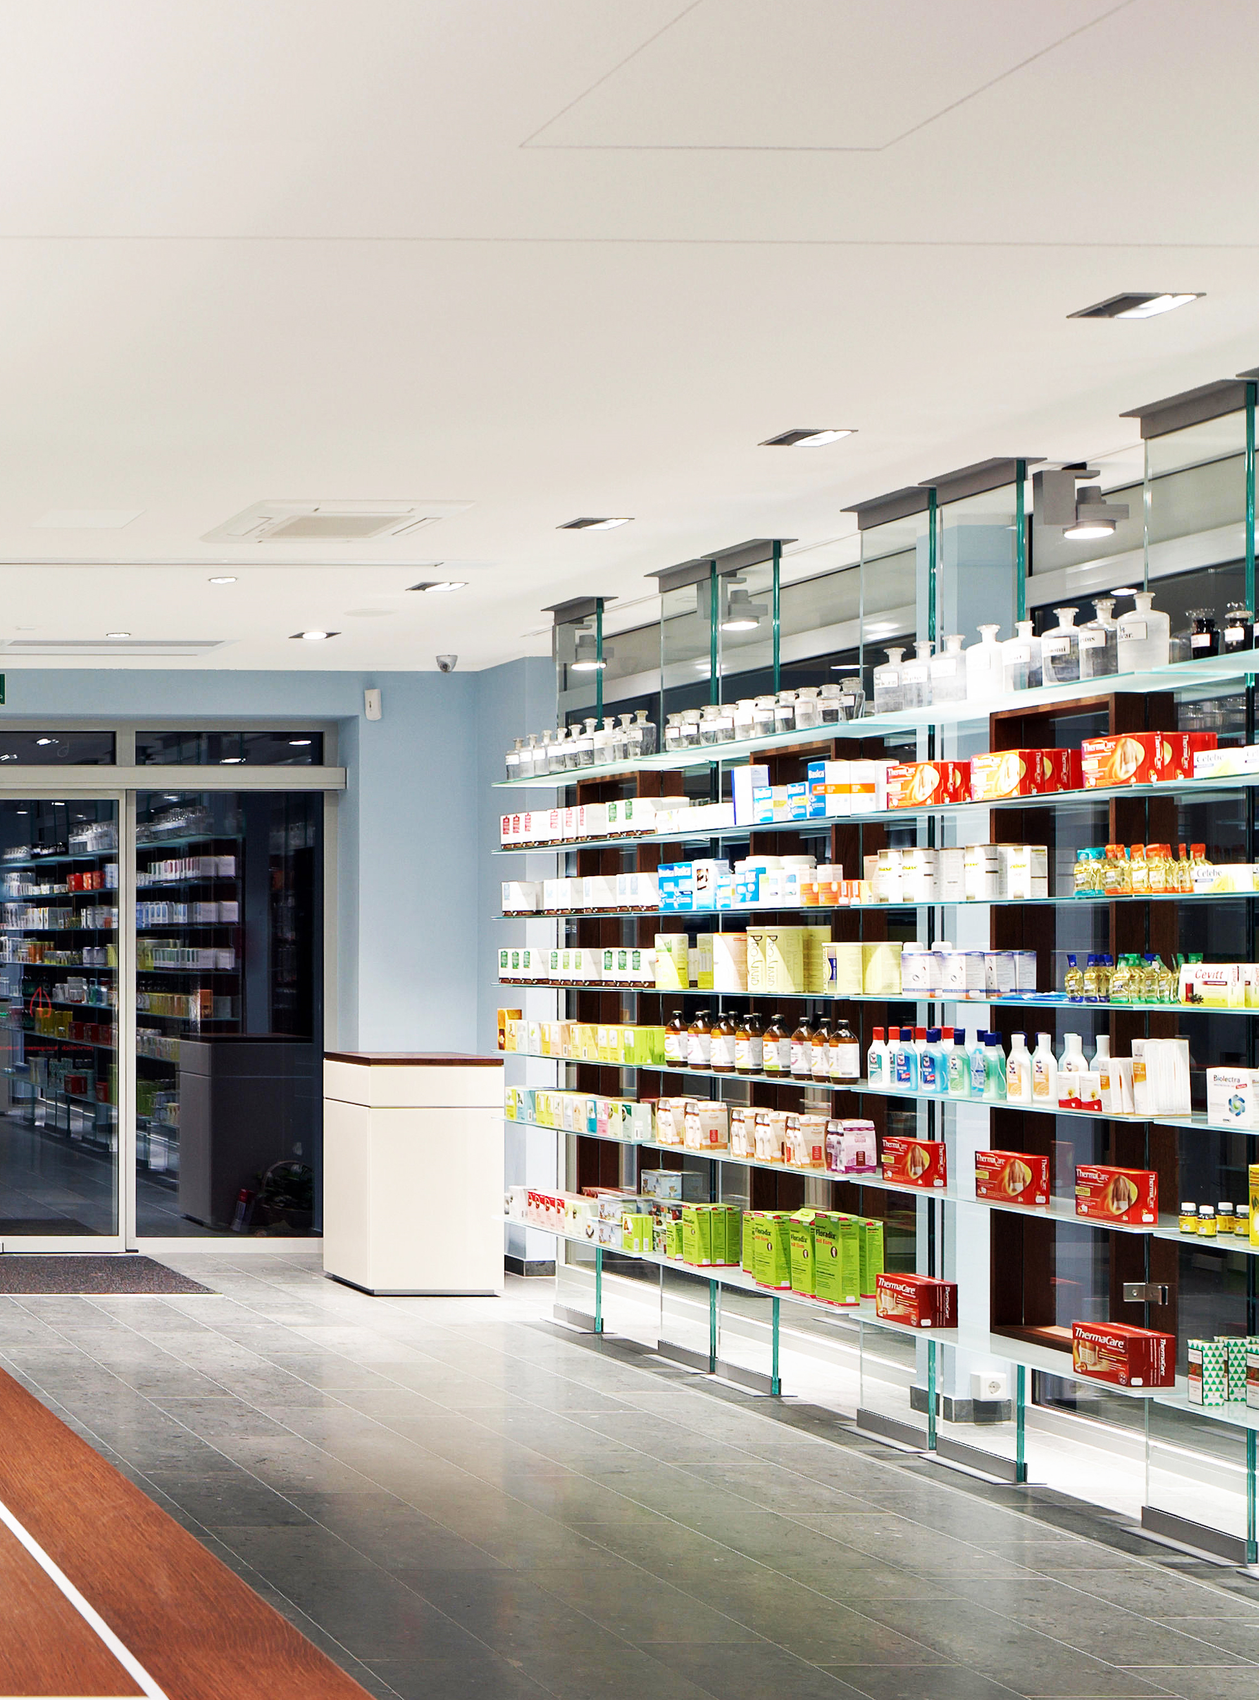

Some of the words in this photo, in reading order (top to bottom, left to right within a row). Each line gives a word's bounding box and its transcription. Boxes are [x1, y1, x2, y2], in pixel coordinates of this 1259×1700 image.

[1194, 969, 1224, 980] Cevitt
[1213, 1074, 1241, 1083] Biolectra
[1076, 1168, 1109, 1182] ThermaCare
[878, 1277, 916, 1294] ThermaCare
[1075, 1327, 1124, 1348] ThermaCare
